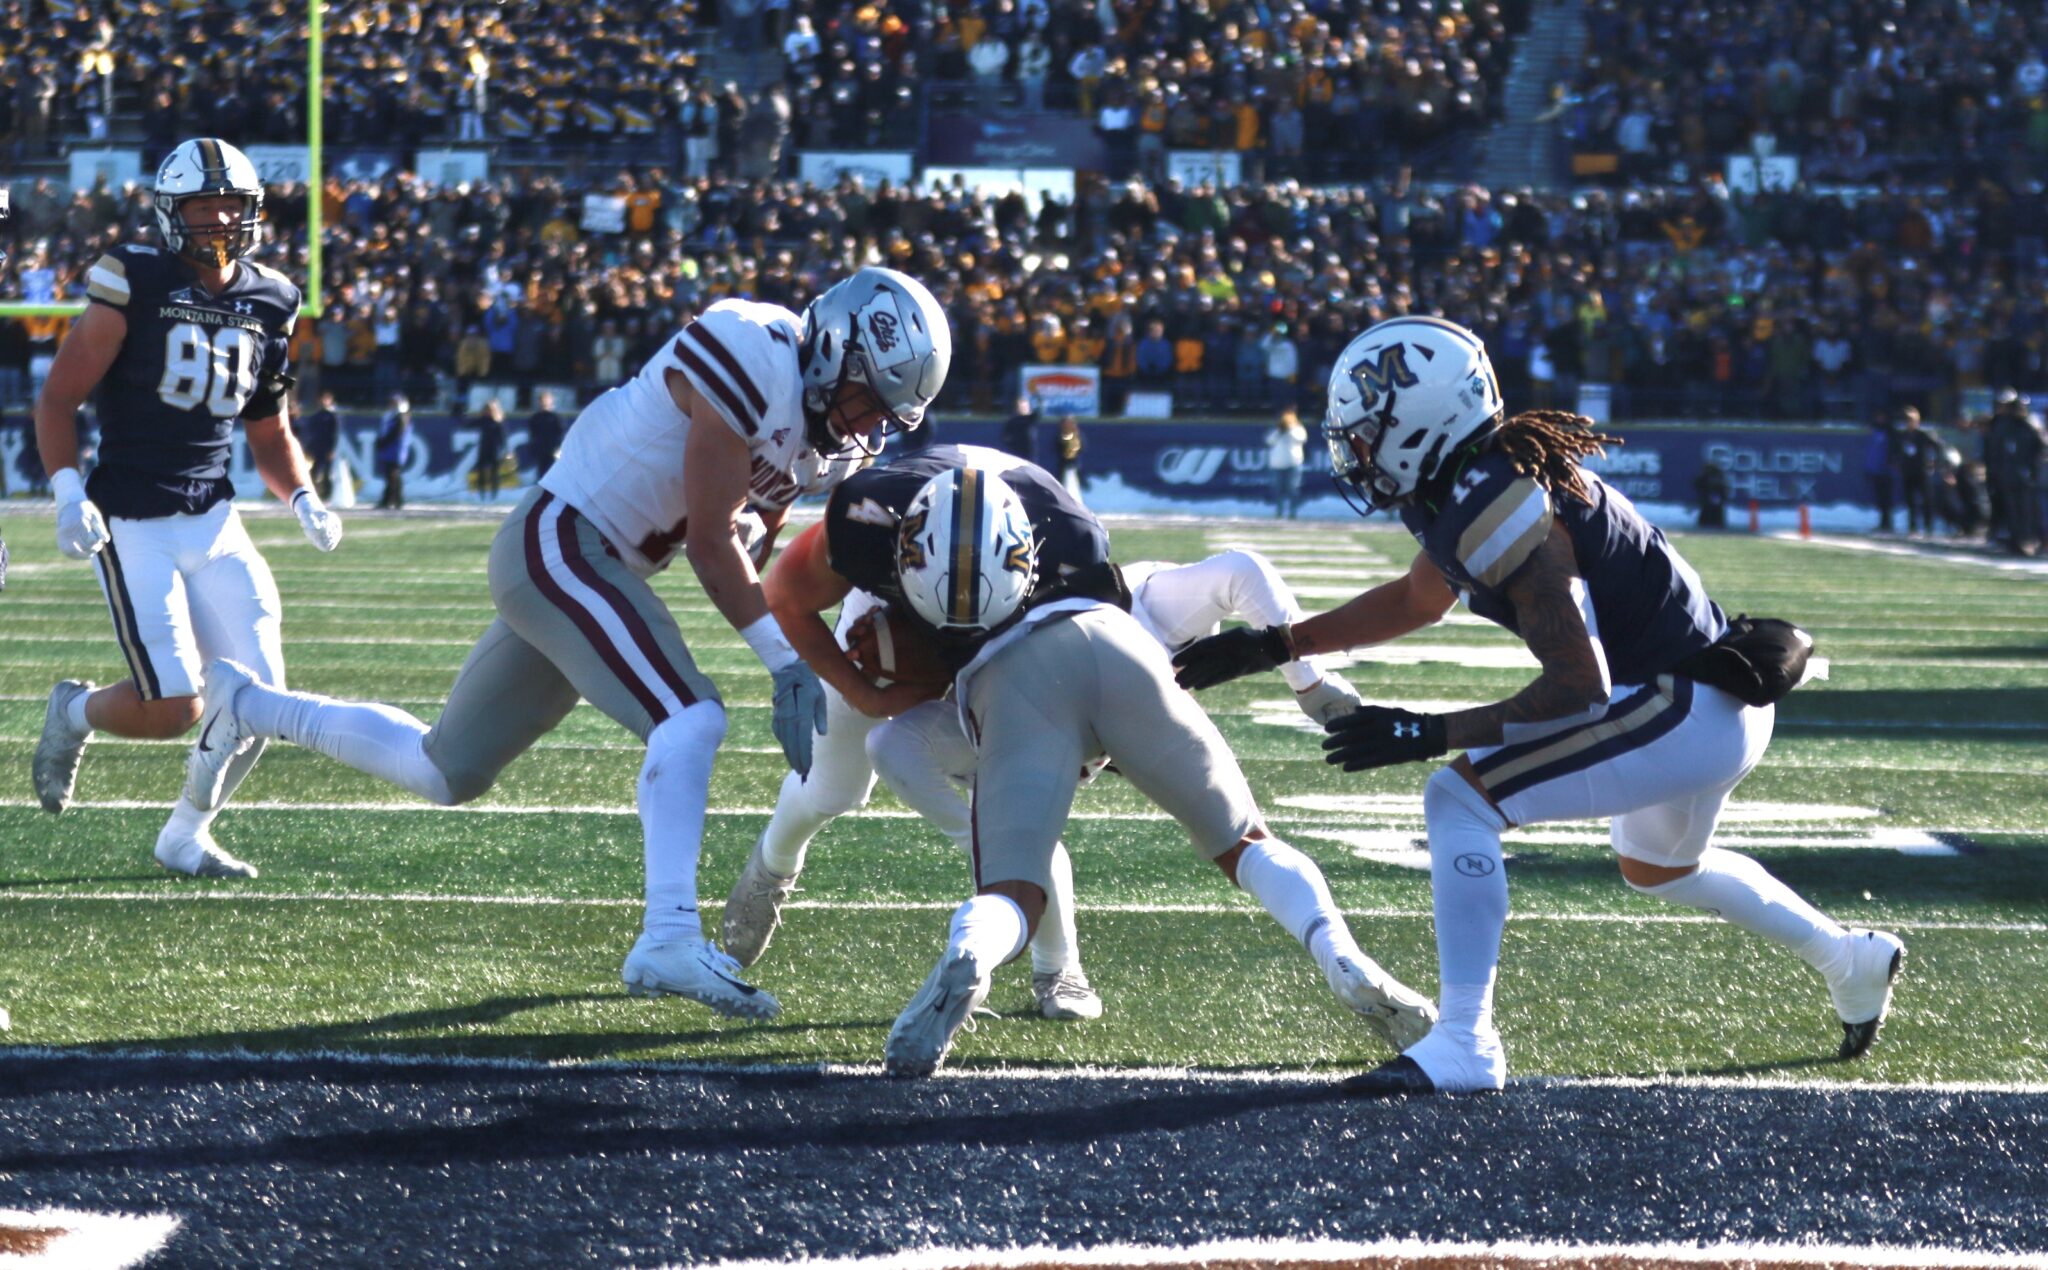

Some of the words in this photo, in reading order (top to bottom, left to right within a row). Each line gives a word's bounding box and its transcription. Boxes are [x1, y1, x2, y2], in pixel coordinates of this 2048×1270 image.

[160, 306, 223, 325] MONTANA
[157, 322, 258, 418] 80
[1350, 341, 1420, 412] M
[1706, 445, 1842, 474] GOLDEN
